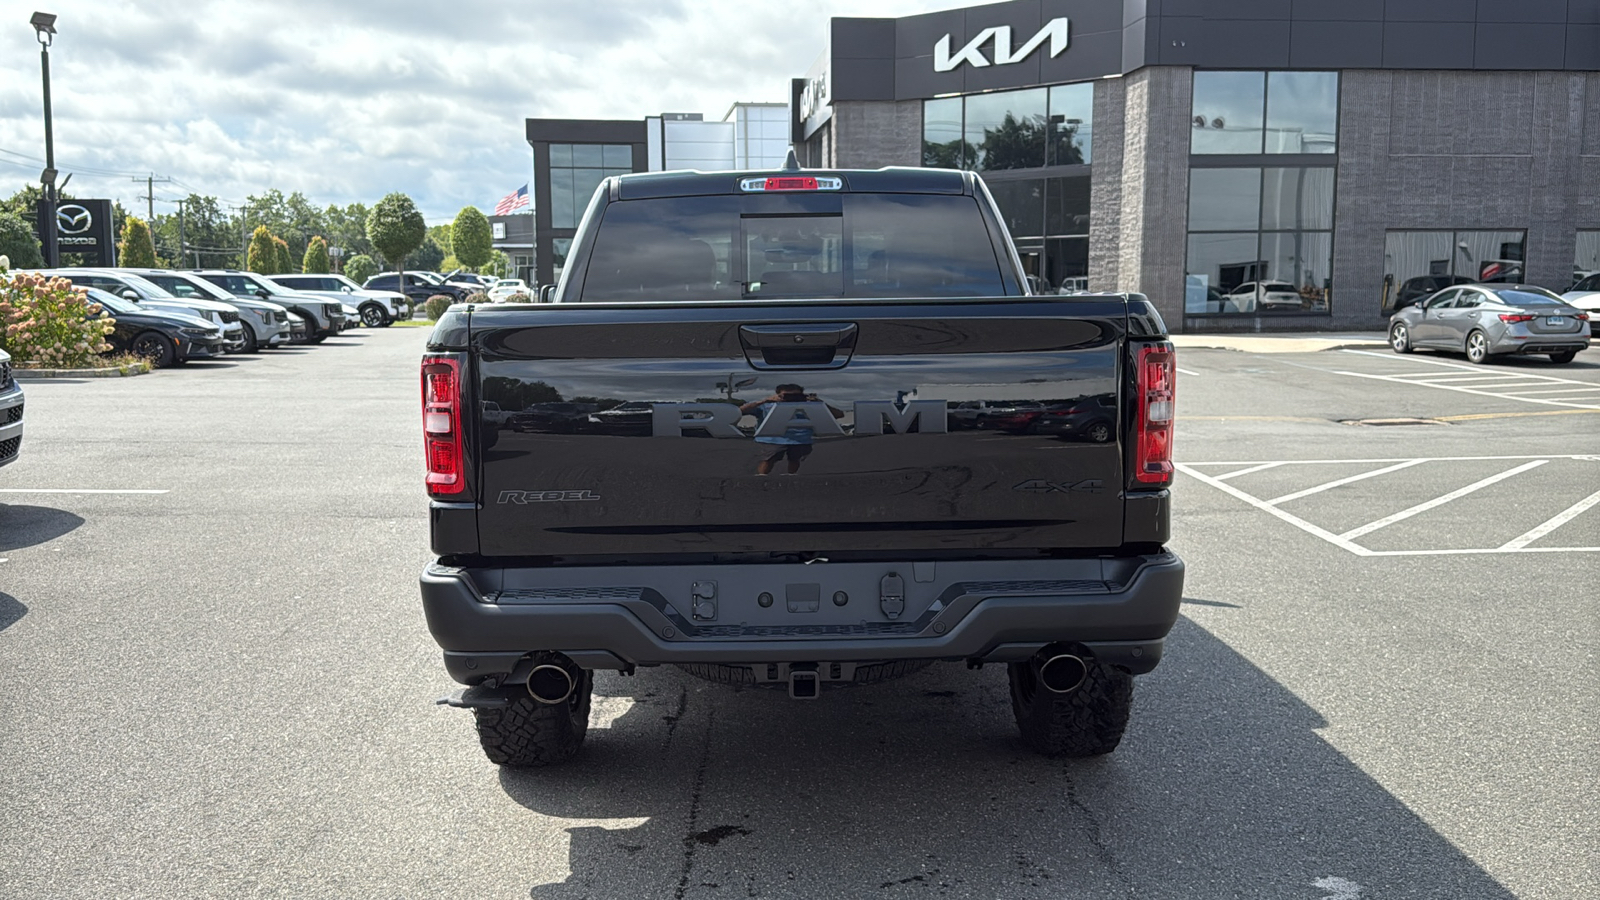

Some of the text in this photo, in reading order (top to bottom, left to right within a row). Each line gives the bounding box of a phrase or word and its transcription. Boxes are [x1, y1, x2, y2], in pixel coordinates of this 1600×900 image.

[934, 17, 1069, 72] KIA
[652, 400, 948, 438] RAM
[496, 489, 601, 504] REBEL
